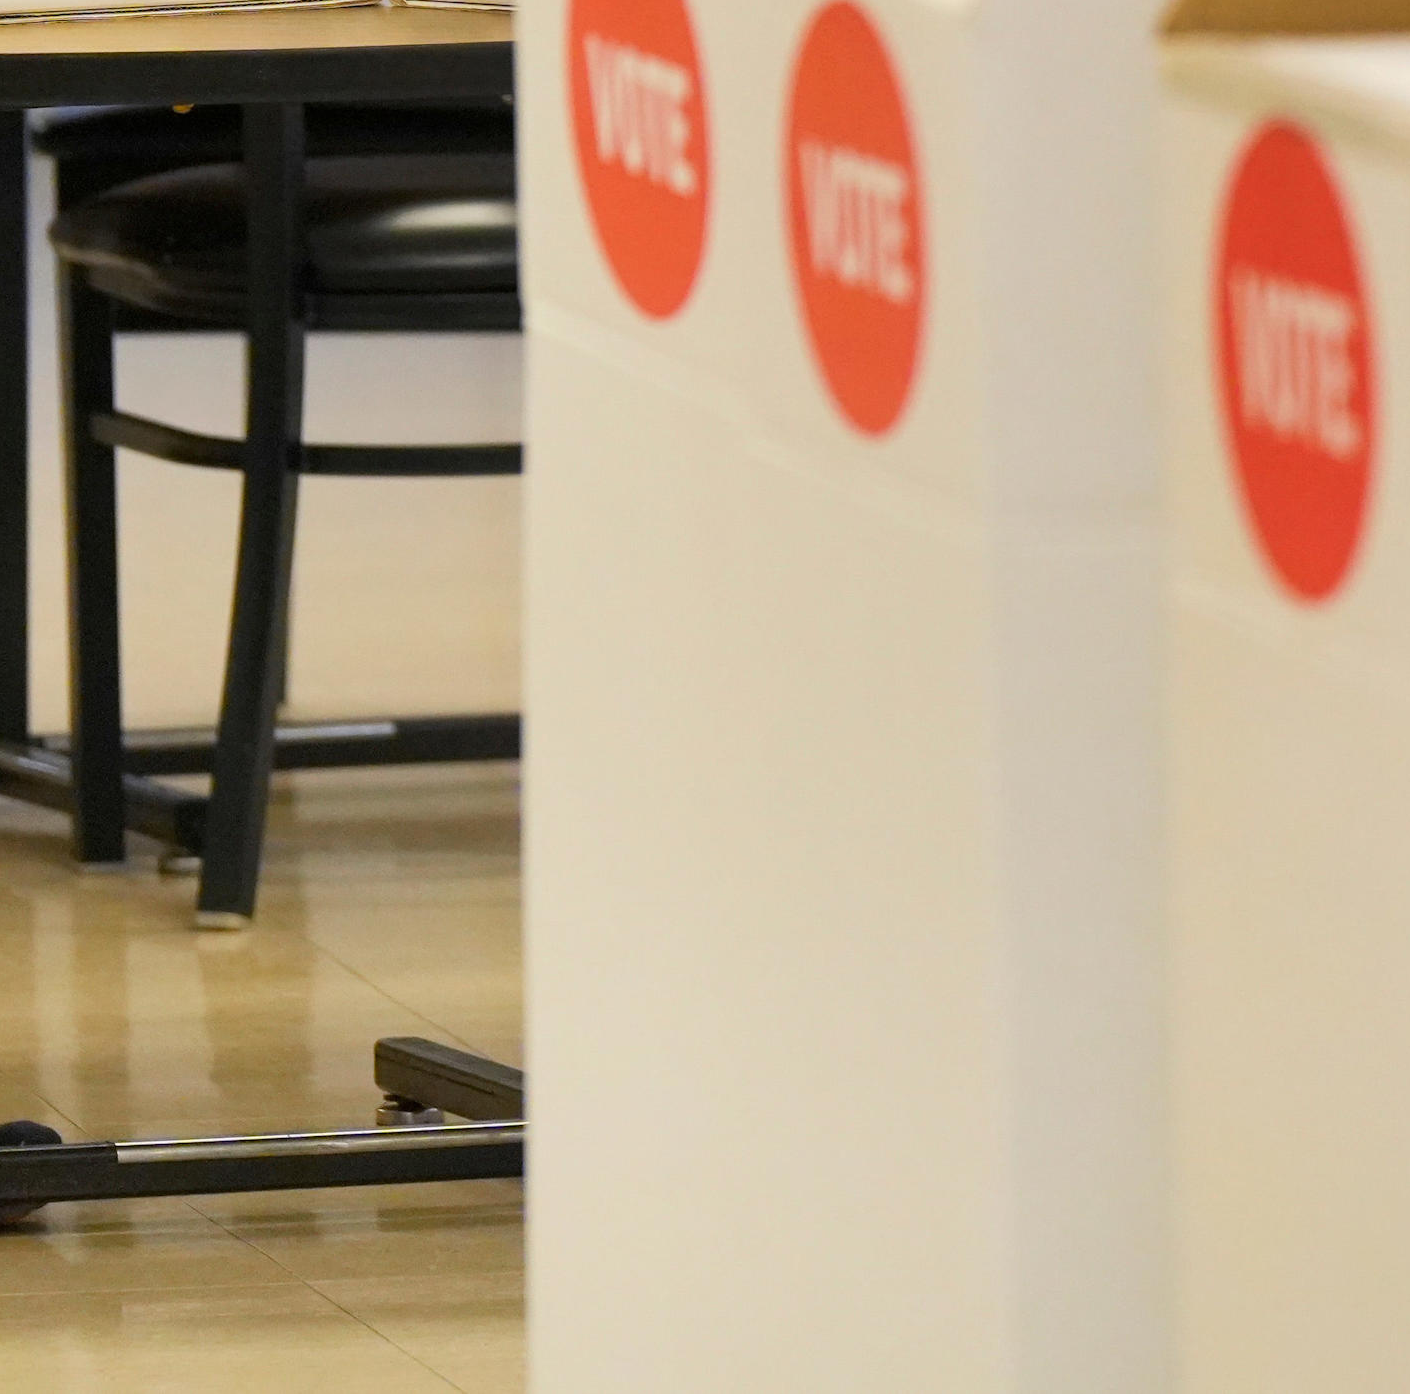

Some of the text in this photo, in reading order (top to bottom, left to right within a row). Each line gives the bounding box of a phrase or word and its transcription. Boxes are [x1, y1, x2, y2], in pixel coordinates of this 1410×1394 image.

[584, 30, 700, 198] VOTE
[797, 138, 914, 303] VOTE
[1228, 263, 1364, 459] VOTE
